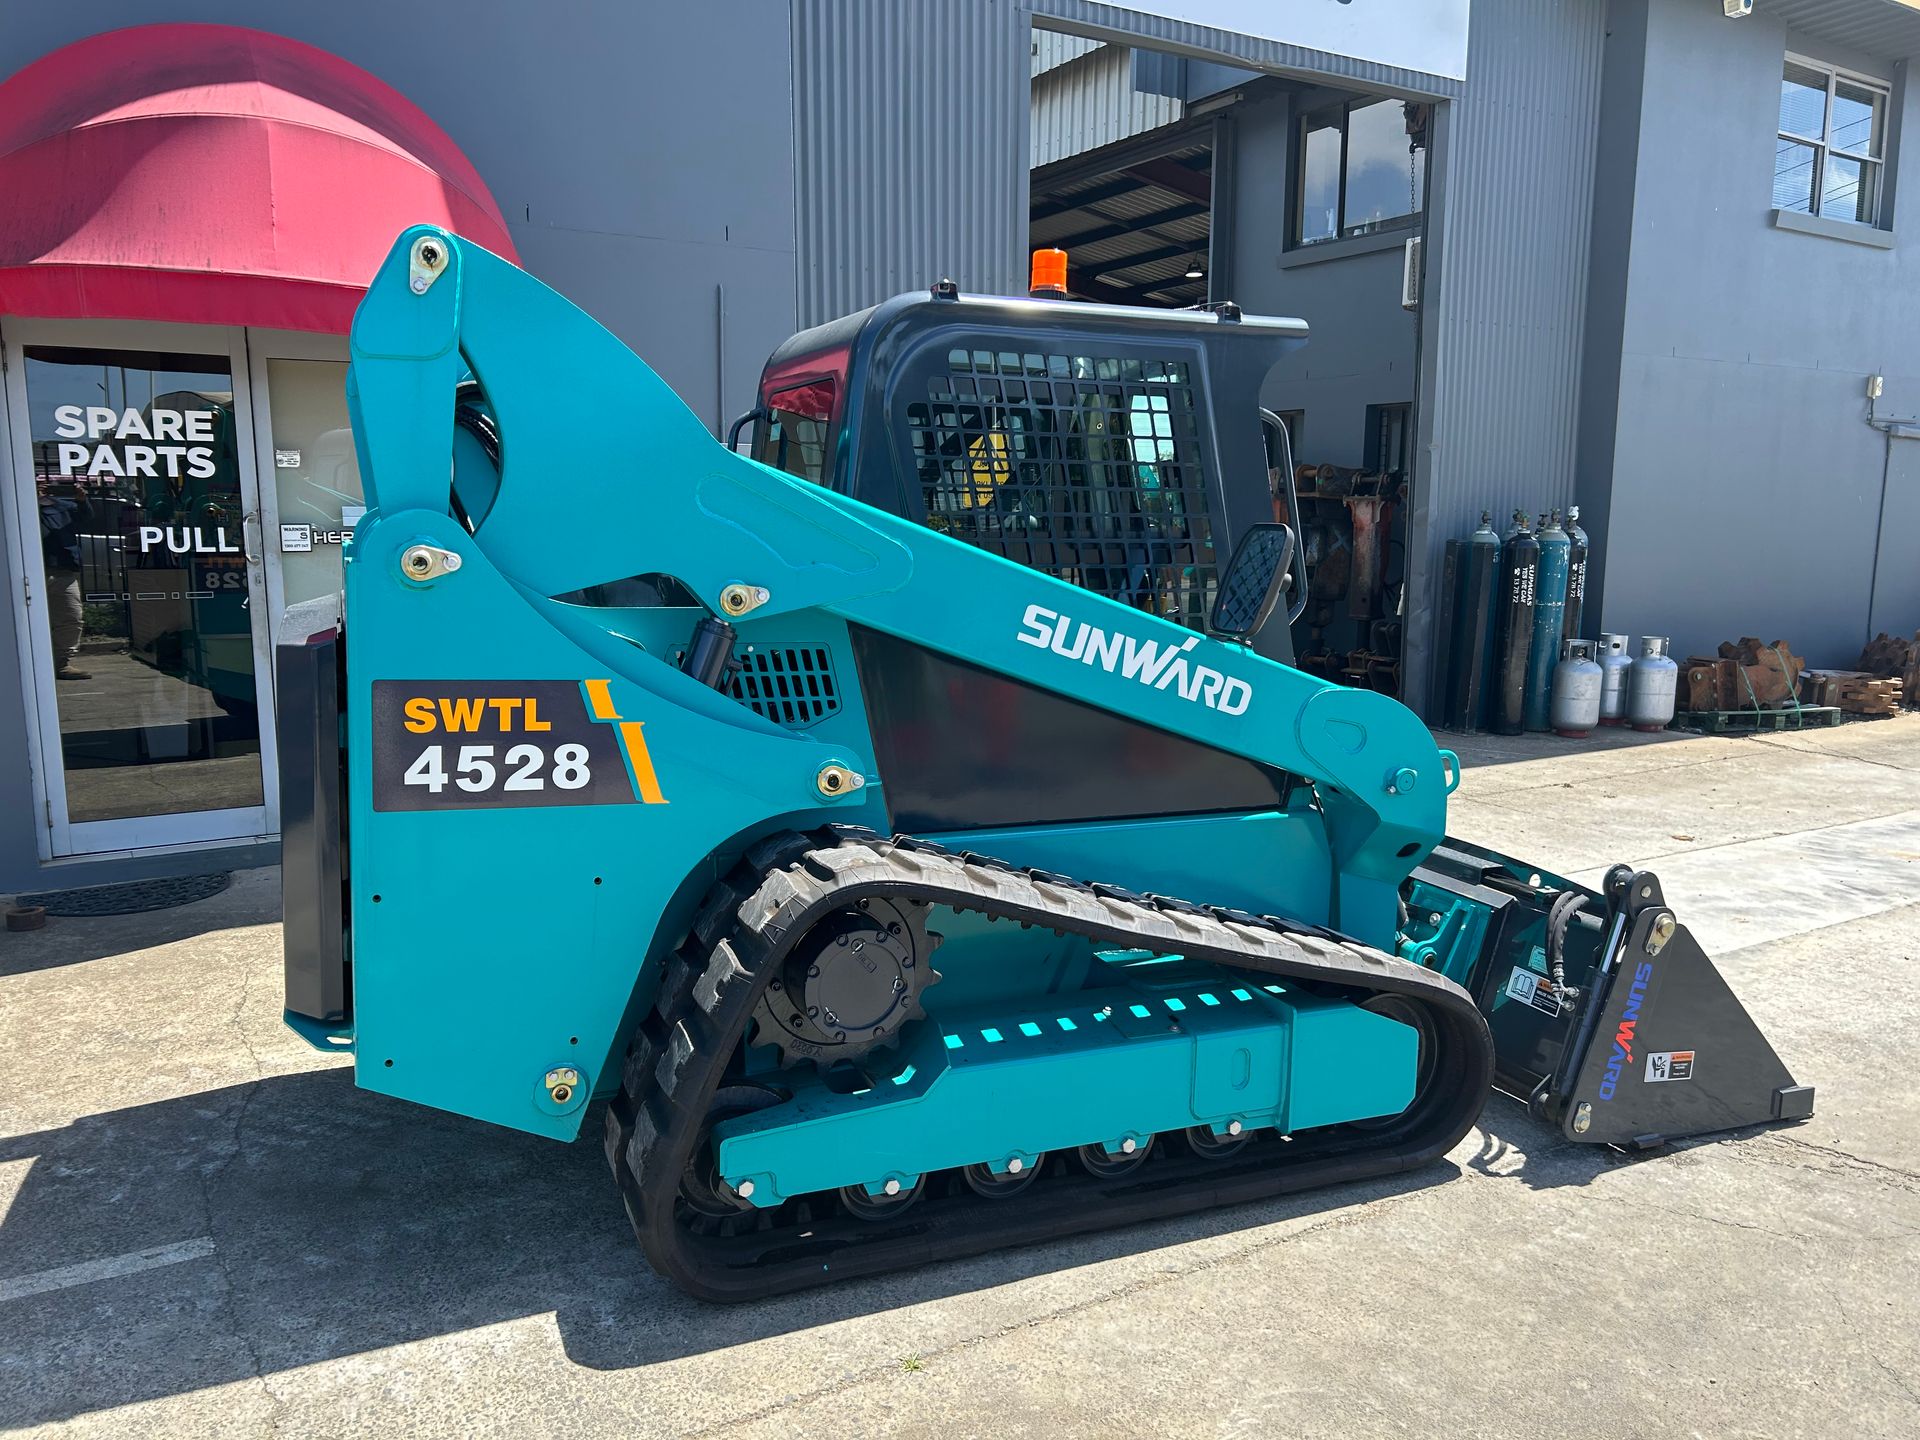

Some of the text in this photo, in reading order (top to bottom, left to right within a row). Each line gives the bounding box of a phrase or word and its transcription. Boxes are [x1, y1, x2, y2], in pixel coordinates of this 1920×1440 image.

[54, 405, 215, 442] SPARE
[58, 444, 216, 479] PARTS
[139, 526, 240, 553] PULL
[1527, 563, 1535, 607] SUPAGAS
[1016, 604, 1253, 716] SUNWARD
[404, 697, 552, 734] SWTL
[404, 743, 591, 793] 4528
[1599, 962, 1653, 1101] SUNWARD
